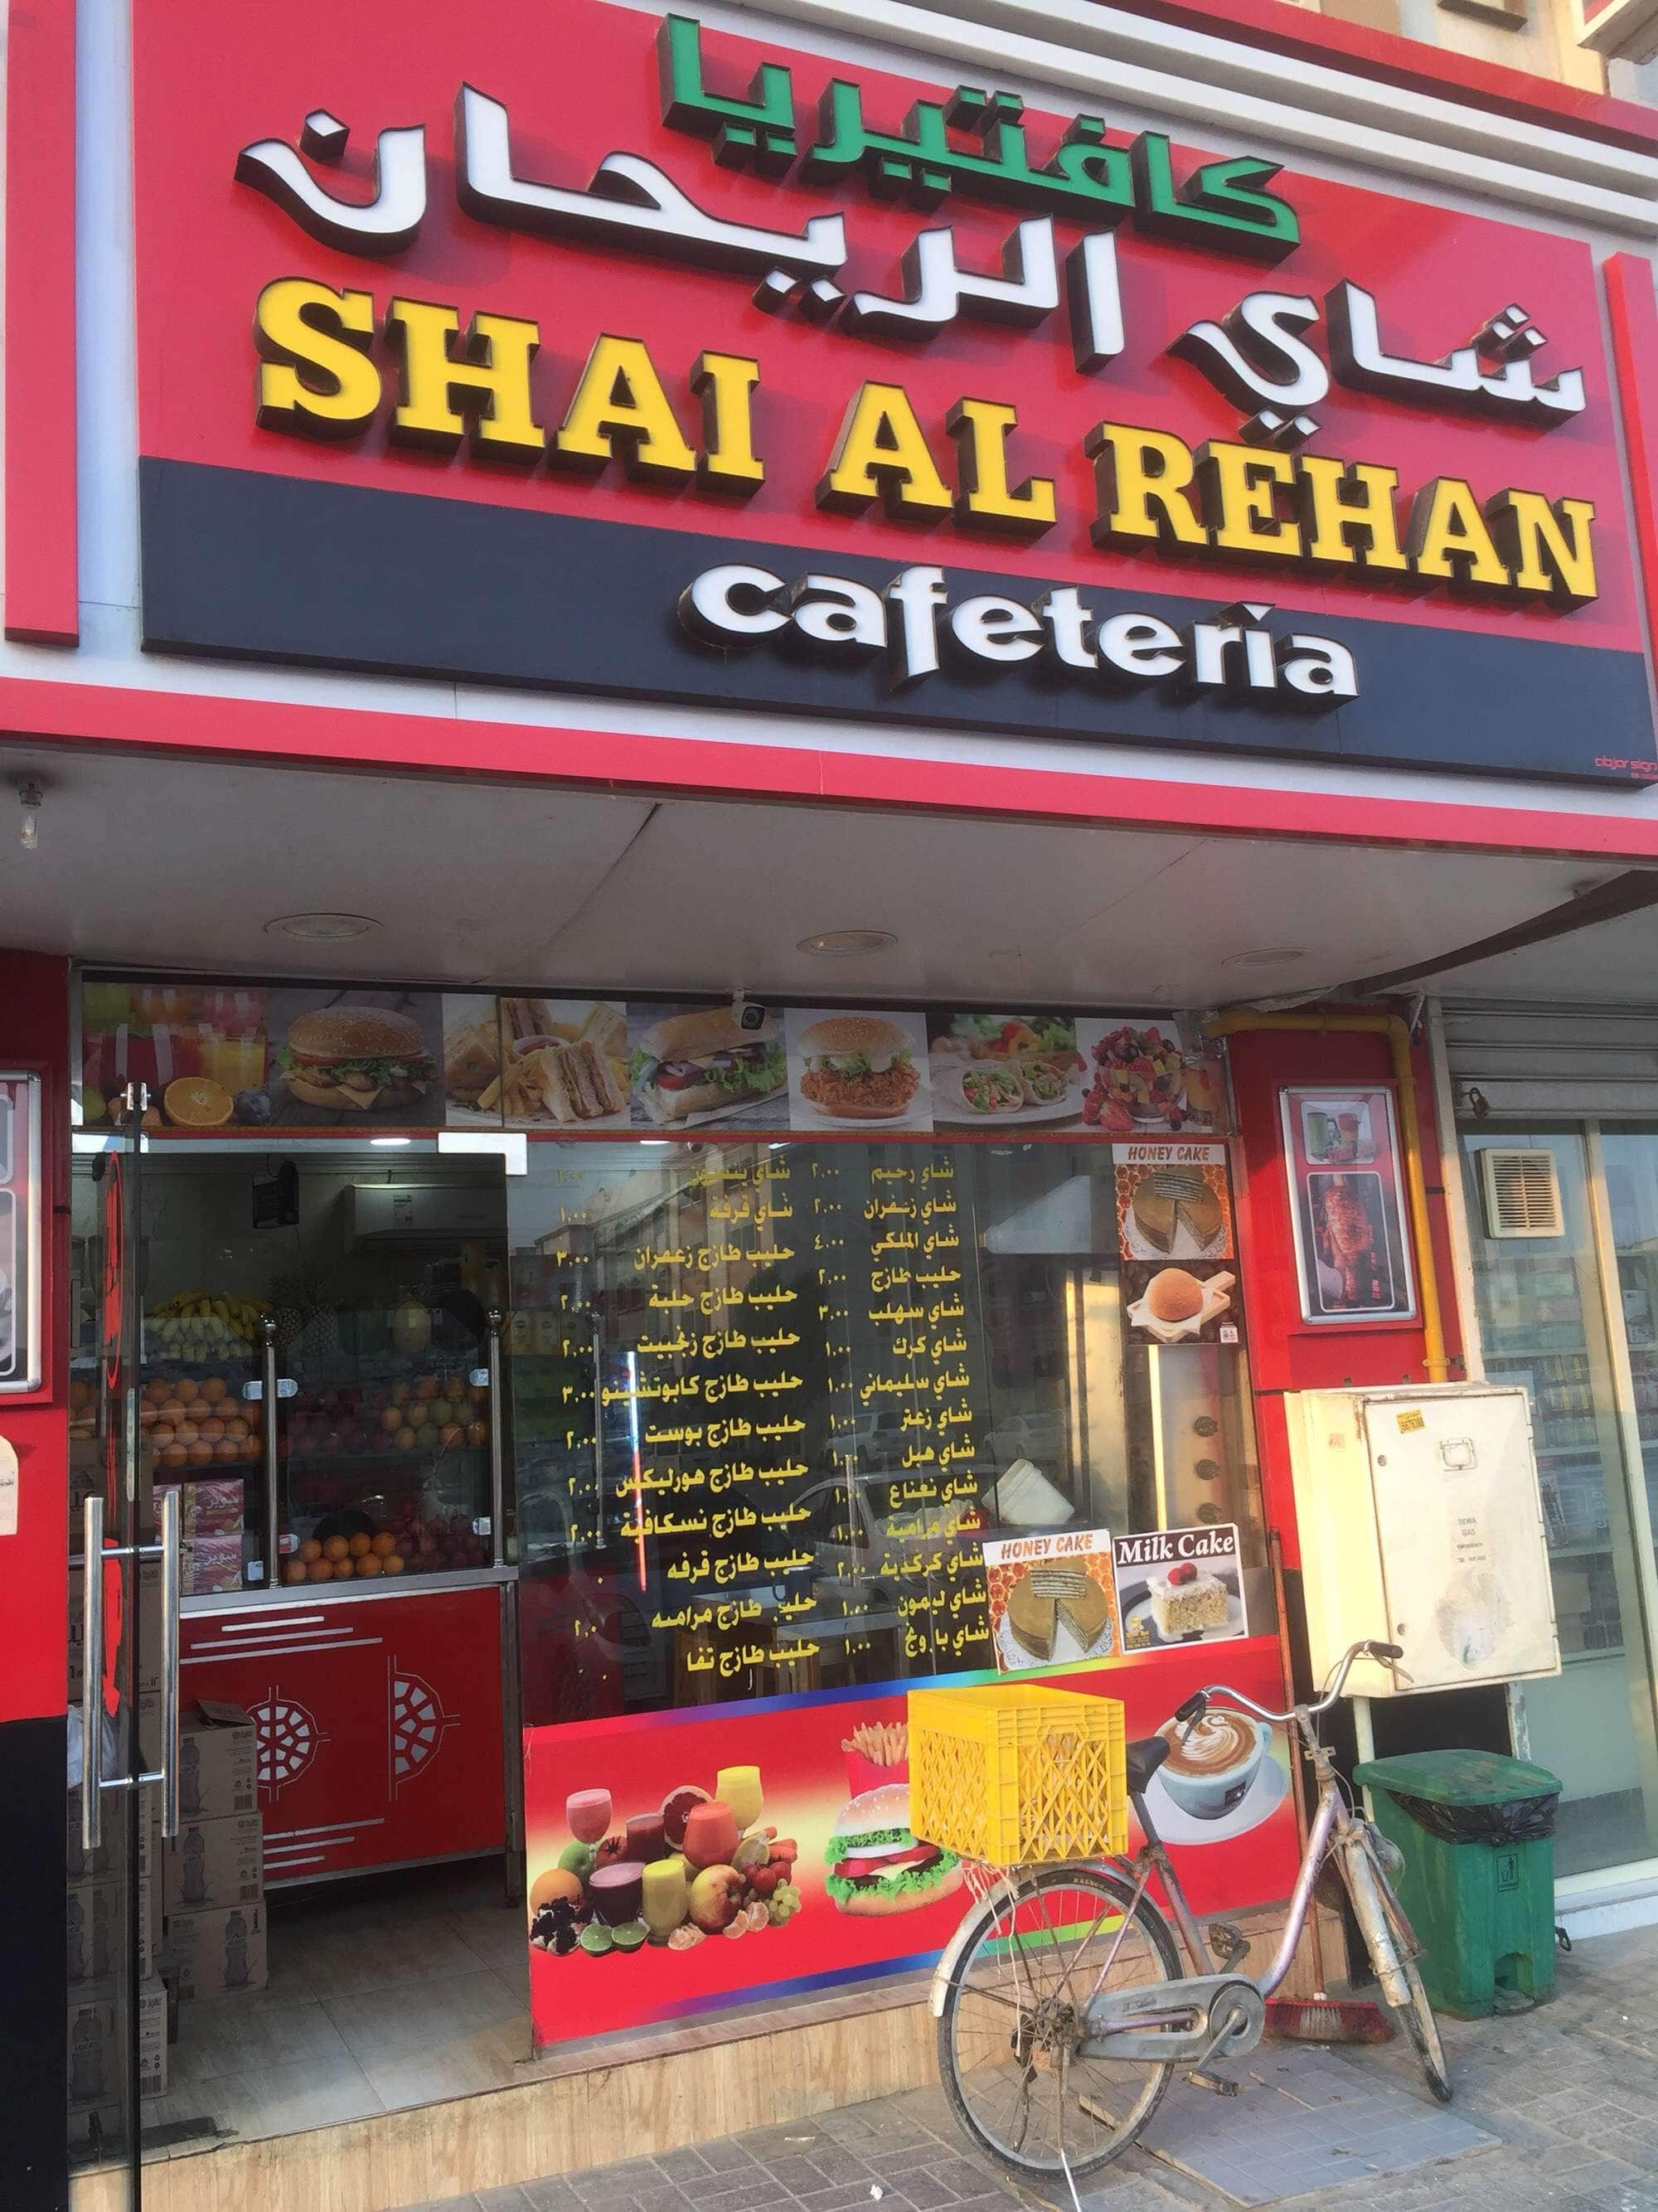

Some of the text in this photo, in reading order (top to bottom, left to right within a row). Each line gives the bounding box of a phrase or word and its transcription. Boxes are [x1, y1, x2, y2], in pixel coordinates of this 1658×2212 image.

[661, 14, 1299, 259] كافتيريا
[237, 82, 1587, 441] شاي الريحان
[255, 277, 1598, 604] SHAI AL REHAN
[685, 564, 1360, 705] cafeteria
[1128, 1146, 1210, 1161] HONEY CAKE
[921, 1190, 957, 1225] شاي
[697, 1243, 742, 1272] طازج
[744, 1244, 795, 1268] حليب
[924, 1224, 959, 1259] شاي
[871, 1267, 911, 1293] طازج
[915, 1265, 961, 1289] حليب
[700, 1287, 744, 1315] طازج
[746, 1284, 797, 1311] حليب
[928, 1293, 965, 1329] شاي
[702, 1329, 747, 1359] طازج
[750, 1327, 801, 1354] حليب
[931, 1327, 967, 1365] شاي
[705, 1372, 749, 1404] طازج
[753, 1370, 803, 1398] حليب
[933, 1362, 970, 1400] شاي
[706, 1417, 752, 1448] طازج
[755, 1414, 806, 1443] حليب
[937, 1398, 973, 1438] شاي
[938, 1433, 976, 1472] شاي
[709, 1461, 754, 1492] طازج
[758, 1458, 809, 1487] حليب
[941, 1467, 978, 1511] شاي
[711, 1506, 757, 1538] طازج
[760, 1502, 812, 1531] حليب
[763, 1549, 815, 1576] حليب
[947, 1541, 984, 1582] شاي
[1001, 1534, 1093, 1560] HONEY CAKE
[1117, 1530, 1234, 1564] Milk Cake
[714, 1552, 759, 1584] طازج
[949, 1579, 989, 1622] شاي
[953, 1612, 991, 1657] شاي
[719, 1644, 767, 1677] طازج
[766, 1638, 821, 1668] حليب
